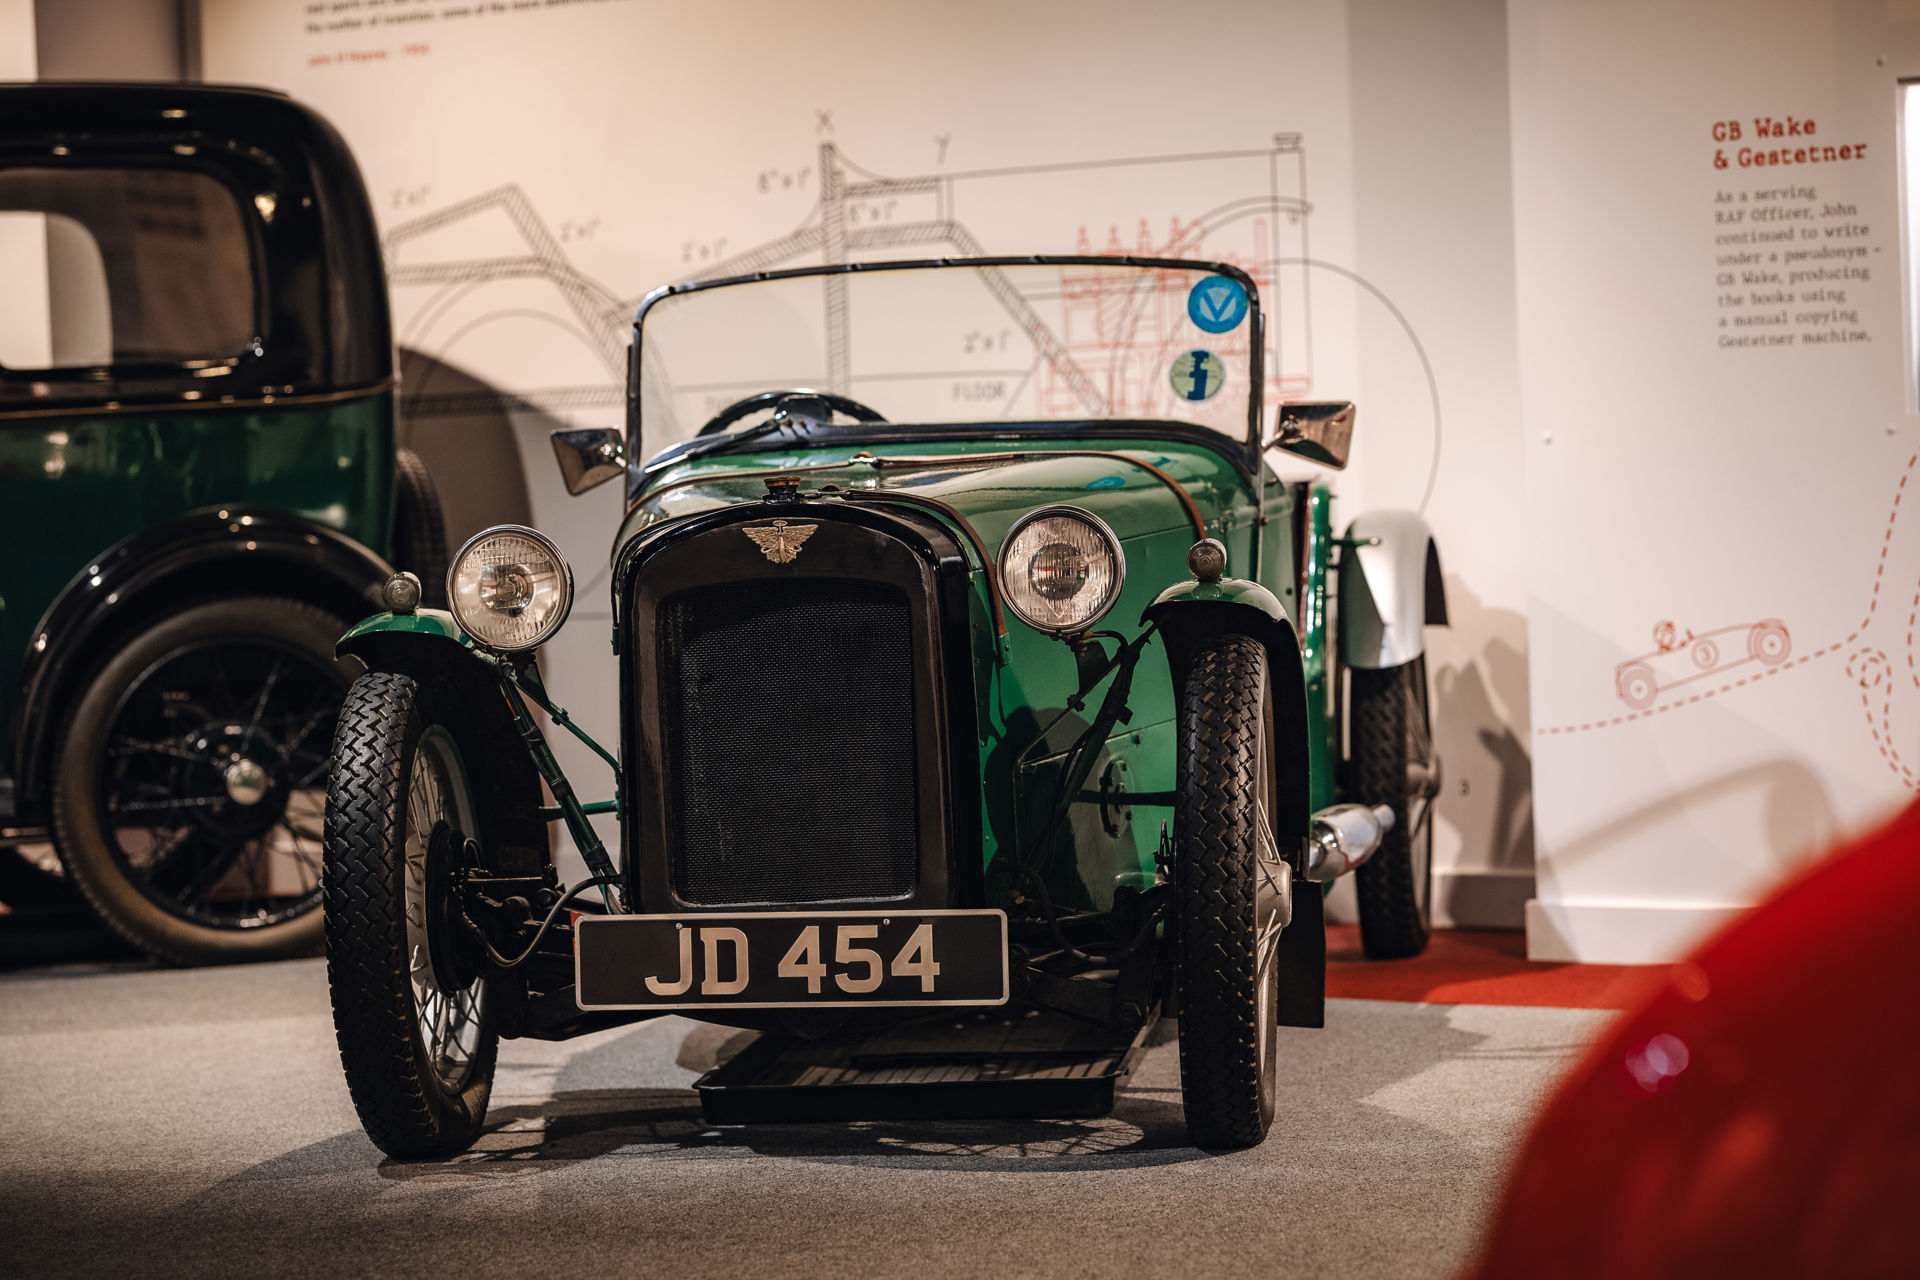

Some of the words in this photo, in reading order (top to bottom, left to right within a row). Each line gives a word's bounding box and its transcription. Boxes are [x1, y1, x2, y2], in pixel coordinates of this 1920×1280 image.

[1712, 120, 1742, 142] GB
[1753, 115, 1817, 139] Wake
[1713, 149, 1729, 170] &
[1737, 143, 1868, 168] Gestetner
[1714, 189, 1734, 204] As
[1739, 190, 1748, 202] a
[1754, 184, 1818, 200] serving
[1715, 209, 1746, 225] RAF
[1750, 205, 1815, 223] Officer,
[1820, 202, 1858, 218] John
[1715, 227, 1795, 246] continued
[1801, 228, 1818, 240] to
[1823, 224, 1870, 238] write
[1716, 251, 1761, 267] under
[1768, 252, 1778, 263] a
[1784, 245, 1868, 265] pseudonym
[1716, 272, 1736, 287] GB
[1741, 270, 1784, 286] Wake,
[1789, 266, 1871, 285] producing
[1717, 294, 1744, 307] the
[1750, 289, 1795, 306] books
[1801, 287, 1847, 305] using
[1718, 316, 1728, 328] a
[1733, 309, 1788, 327] manual
[1795, 307, 1859, 327] copying
[1717, 333, 1796, 349] Gestetner
[1801, 328, 1873, 345] machine.
[645, 926, 749, 996] JD
[778, 923, 941, 995] 454
